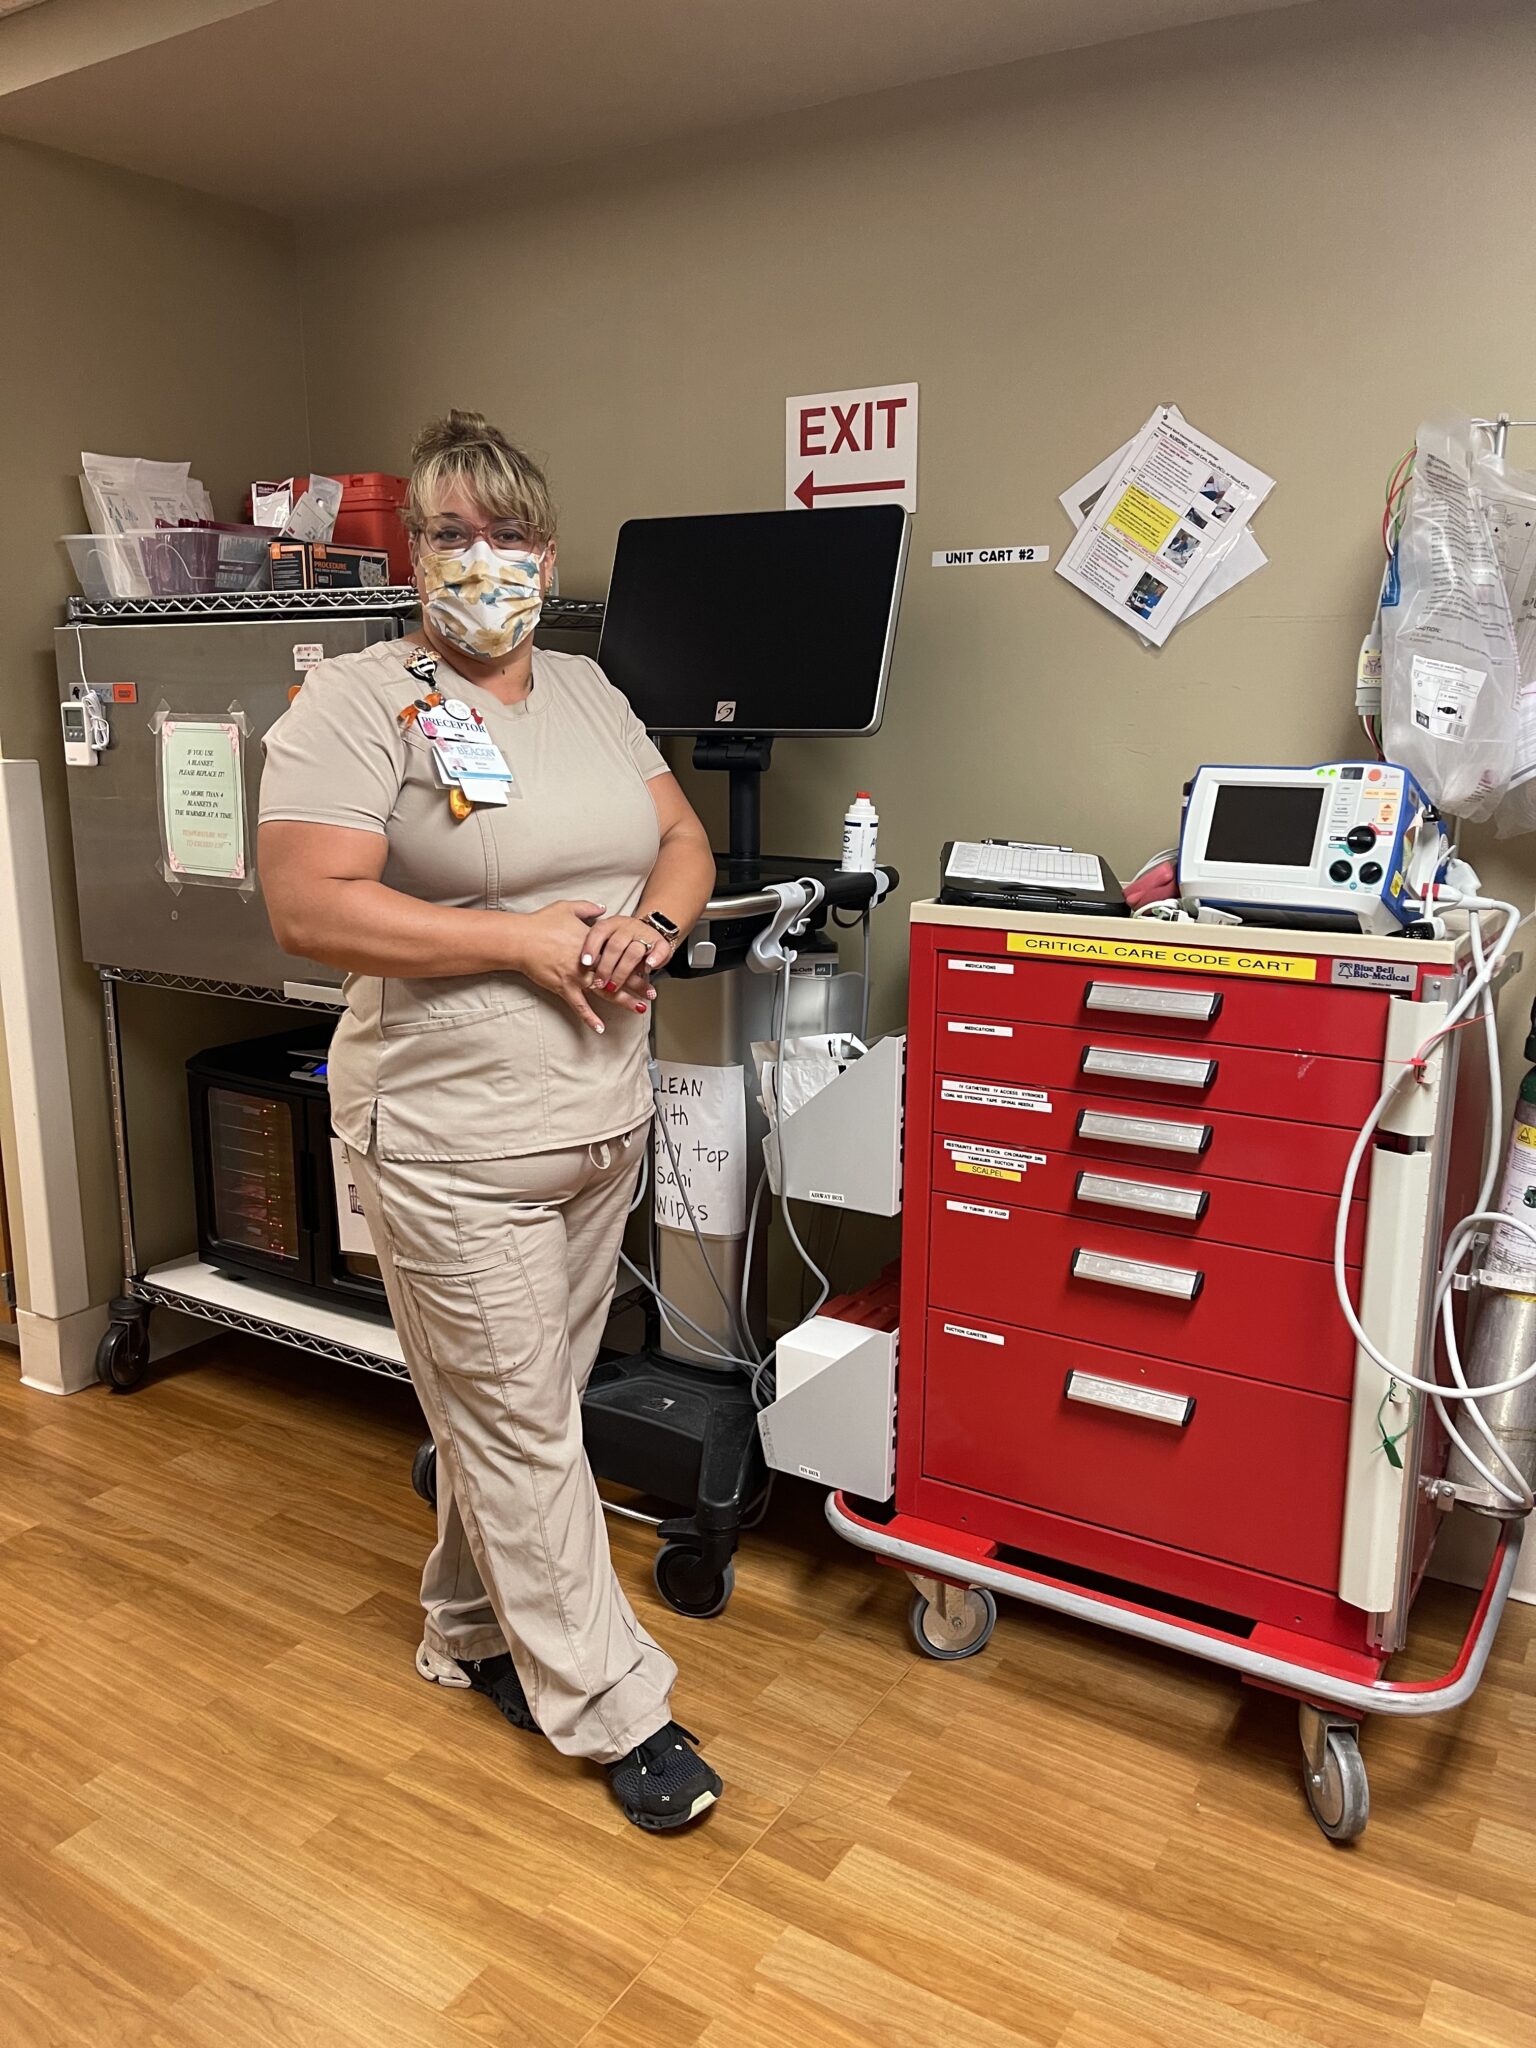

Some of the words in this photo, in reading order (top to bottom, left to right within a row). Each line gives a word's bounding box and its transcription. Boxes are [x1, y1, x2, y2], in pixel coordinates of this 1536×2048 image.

[800, 398, 907, 456] EXIT
[945, 551, 974, 564] UNIT
[979, 550, 1013, 563] CART
[1018, 548, 1034, 561] #2
[314, 560, 348, 571] PROCEDURE
[421, 716, 487, 733] PRECEPTOR
[456, 746, 496, 757] BEACON
[187, 800, 212, 808] BLANKETS
[1025, 939, 1108, 955] CRITICAL
[1114, 947, 1168, 960] CARE
[1173, 952, 1231, 966] CODE
[1237, 958, 1295, 972] CART
[1354, 963, 1374, 972] Blue
[1376, 965, 1395, 974] Bell
[1353, 970, 1410, 983] Bio-Medical
[660, 1074, 703, 1097] LEAN
[1022, 1091, 1044, 1099] SYRINGES
[660, 1103, 689, 1126] ith
[946, 1142, 972, 1150] RESTRAINTS
[692, 1140, 729, 1172] top
[656, 1166, 692, 1188] Sani
[971, 1166, 1004, 1178] SCALPEL
[811, 1192, 831, 1200] AIRWAY
[946, 1326, 965, 1334] SUCTION
[966, 1330, 988, 1339] CANISTER
